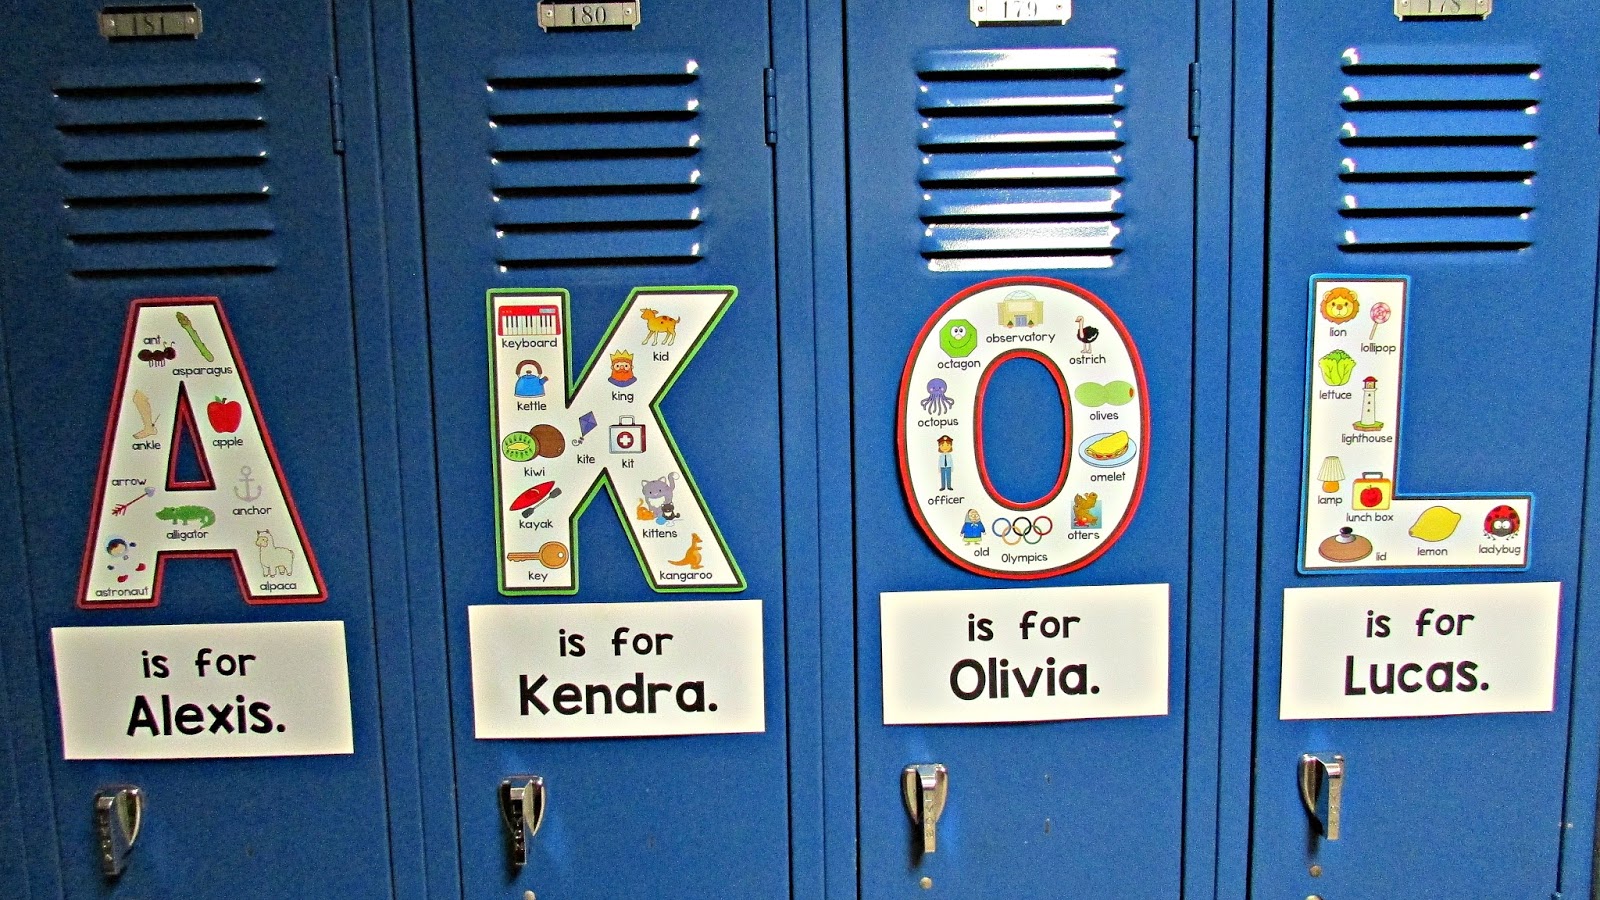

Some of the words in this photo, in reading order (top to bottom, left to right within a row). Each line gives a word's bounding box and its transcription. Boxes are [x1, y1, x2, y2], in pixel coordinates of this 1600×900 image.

[571, 6, 606, 24] 180
[1004, 1, 1038, 18] 179
[1330, 327, 1347, 336] lion
[143, 335, 161, 344] ant
[986, 332, 1055, 343] observatory
[501, 337, 557, 350] keyboard
[1361, 343, 1396, 354] lollipop
[653, 352, 669, 361] kid
[1070, 353, 1106, 364] ostrich
[938, 358, 980, 370] octagon
[172, 367, 232, 377] asparagus
[612, 391, 633, 403] king
[1320, 390, 1351, 399] lettuce
[517, 401, 546, 411] kettle
[1090, 411, 1118, 420] olives
[897, 276, 1151, 580] O
[918, 417, 958, 428] octopus
[1298, 274, 1535, 575] L
[213, 437, 243, 449] apple
[486, 285, 747, 595] K
[1342, 432, 1392, 445] lighthouse
[132, 439, 160, 450] ankle
[76, 296, 327, 609] A
[577, 455, 595, 463] kite
[622, 459, 634, 468] kit
[524, 467, 545, 476] kiwi
[1091, 472, 1125, 481] omelet
[928, 495, 964, 505] officer
[1318, 496, 1342, 506] lamp
[233, 506, 272, 515] anchor
[1346, 513, 1372, 521] lunch
[1375, 513, 1393, 521] box
[519, 518, 553, 531] kayak
[167, 528, 208, 541] alligator
[643, 529, 677, 538] kittens
[1068, 529, 1099, 539] otters
[974, 547, 989, 556] old
[1418, 547, 1447, 555] lemon
[1479, 545, 1520, 556] ladybug
[1002, 554, 1047, 564] Olympics
[1376, 552, 1387, 561] lid
[529, 571, 548, 582] key
[660, 569, 712, 582] kangaroo
[95, 587, 148, 597] astronaut
[260, 581, 297, 592] alpaca
[968, 613, 993, 641] is
[1020, 611, 1080, 639] for
[1367, 610, 1390, 637] is
[1416, 608, 1474, 636] for
[559, 629, 585, 657] is
[612, 627, 673, 656] for
[142, 650, 169, 678] is
[195, 648, 256, 677] for
[950, 656, 1100, 700] Olivia.
[1345, 655, 1489, 696] Lucas.
[519, 673, 717, 716] Kendra.
[127, 695, 285, 736] Alexis.
